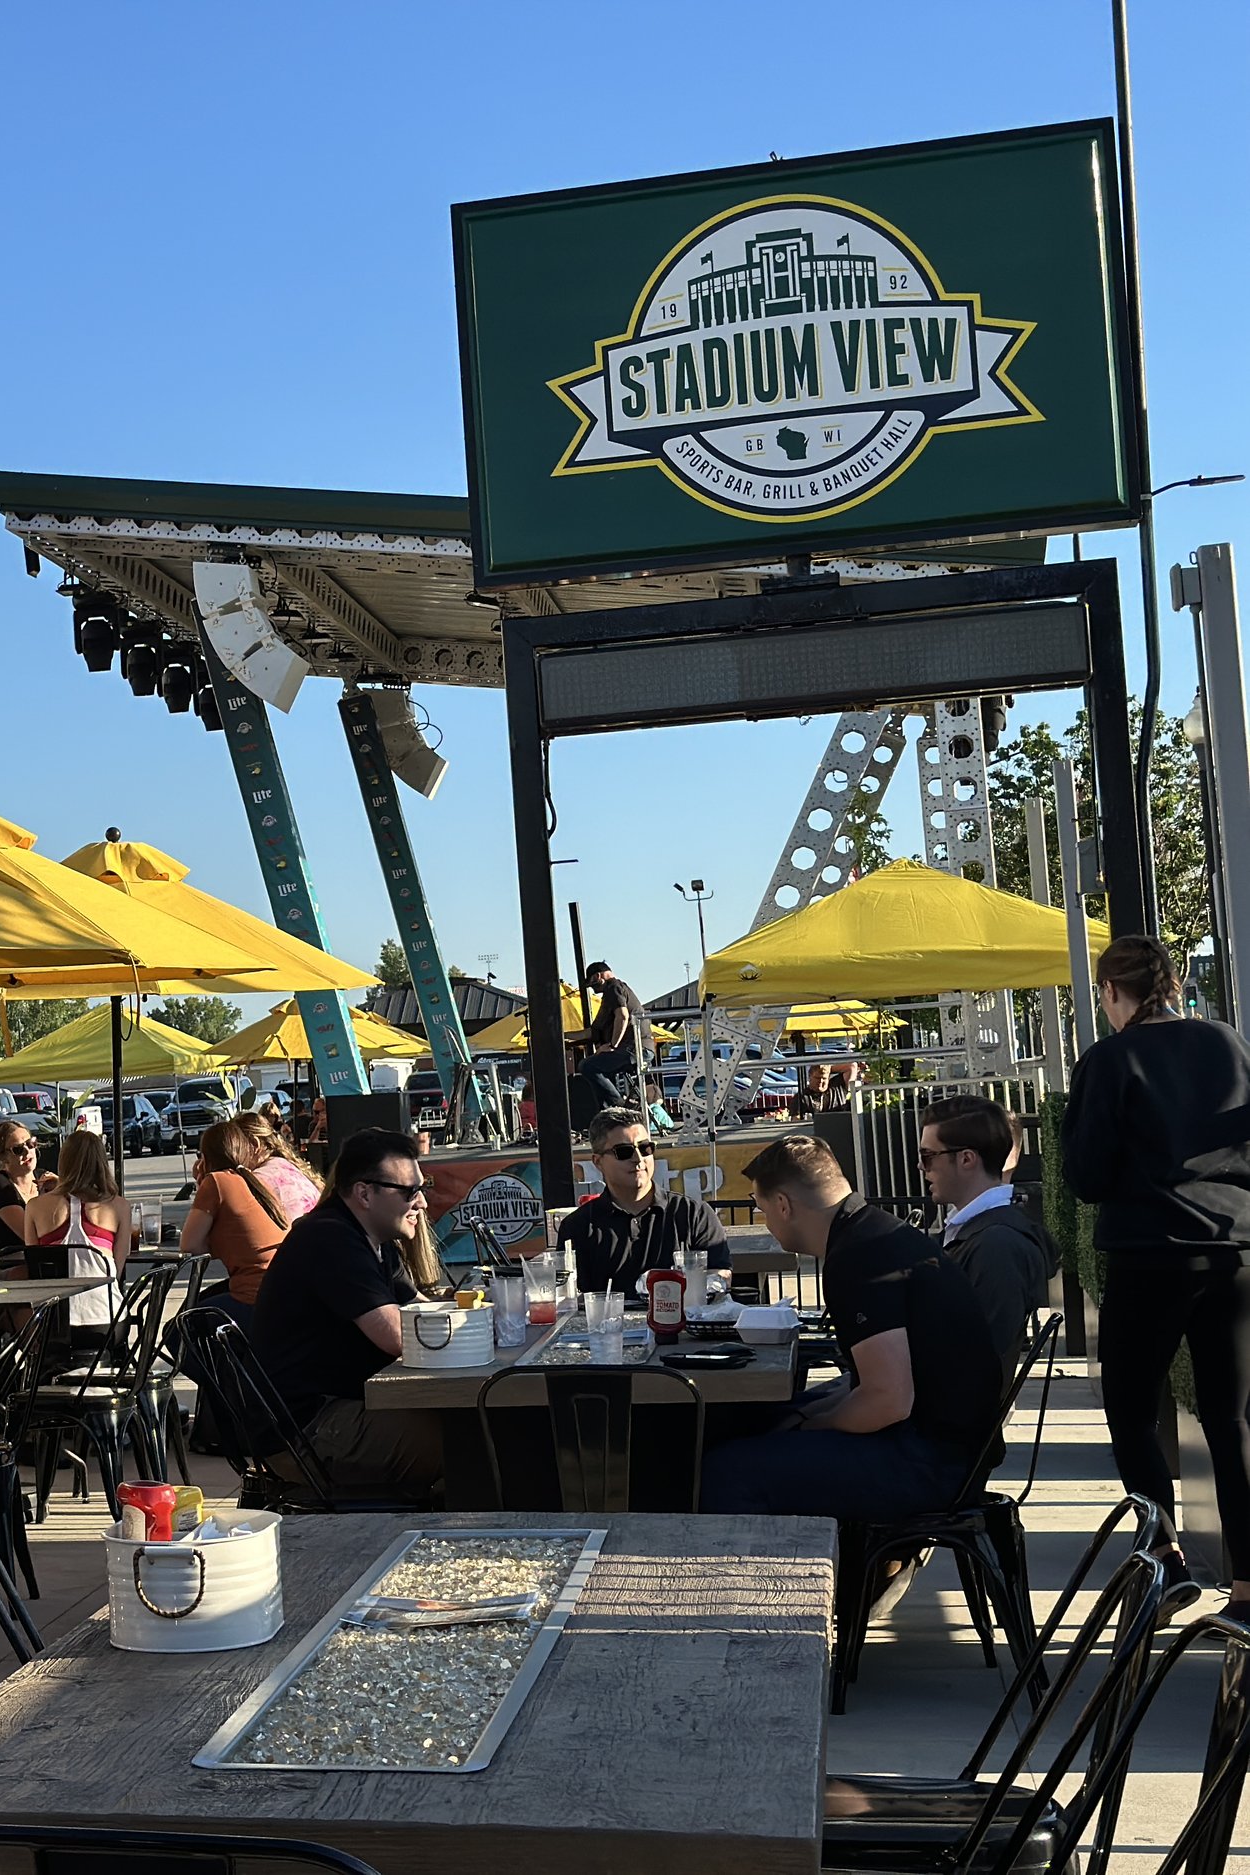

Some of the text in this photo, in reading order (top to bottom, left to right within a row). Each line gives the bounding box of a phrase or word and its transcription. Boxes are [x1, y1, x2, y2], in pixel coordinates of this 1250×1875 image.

[889, 274, 908, 290] 92
[661, 303, 678, 320] 19
[619, 317, 962, 419] STADIUM VIEW
[676, 418, 912, 500] SPORTS BAR, GRILL & BANQUET HALL
[228, 696, 247, 711] Lite
[252, 789, 272, 804] Lite
[278, 882, 298, 897] Lite
[463, 1200, 540, 1221] STADIUM VIEW
